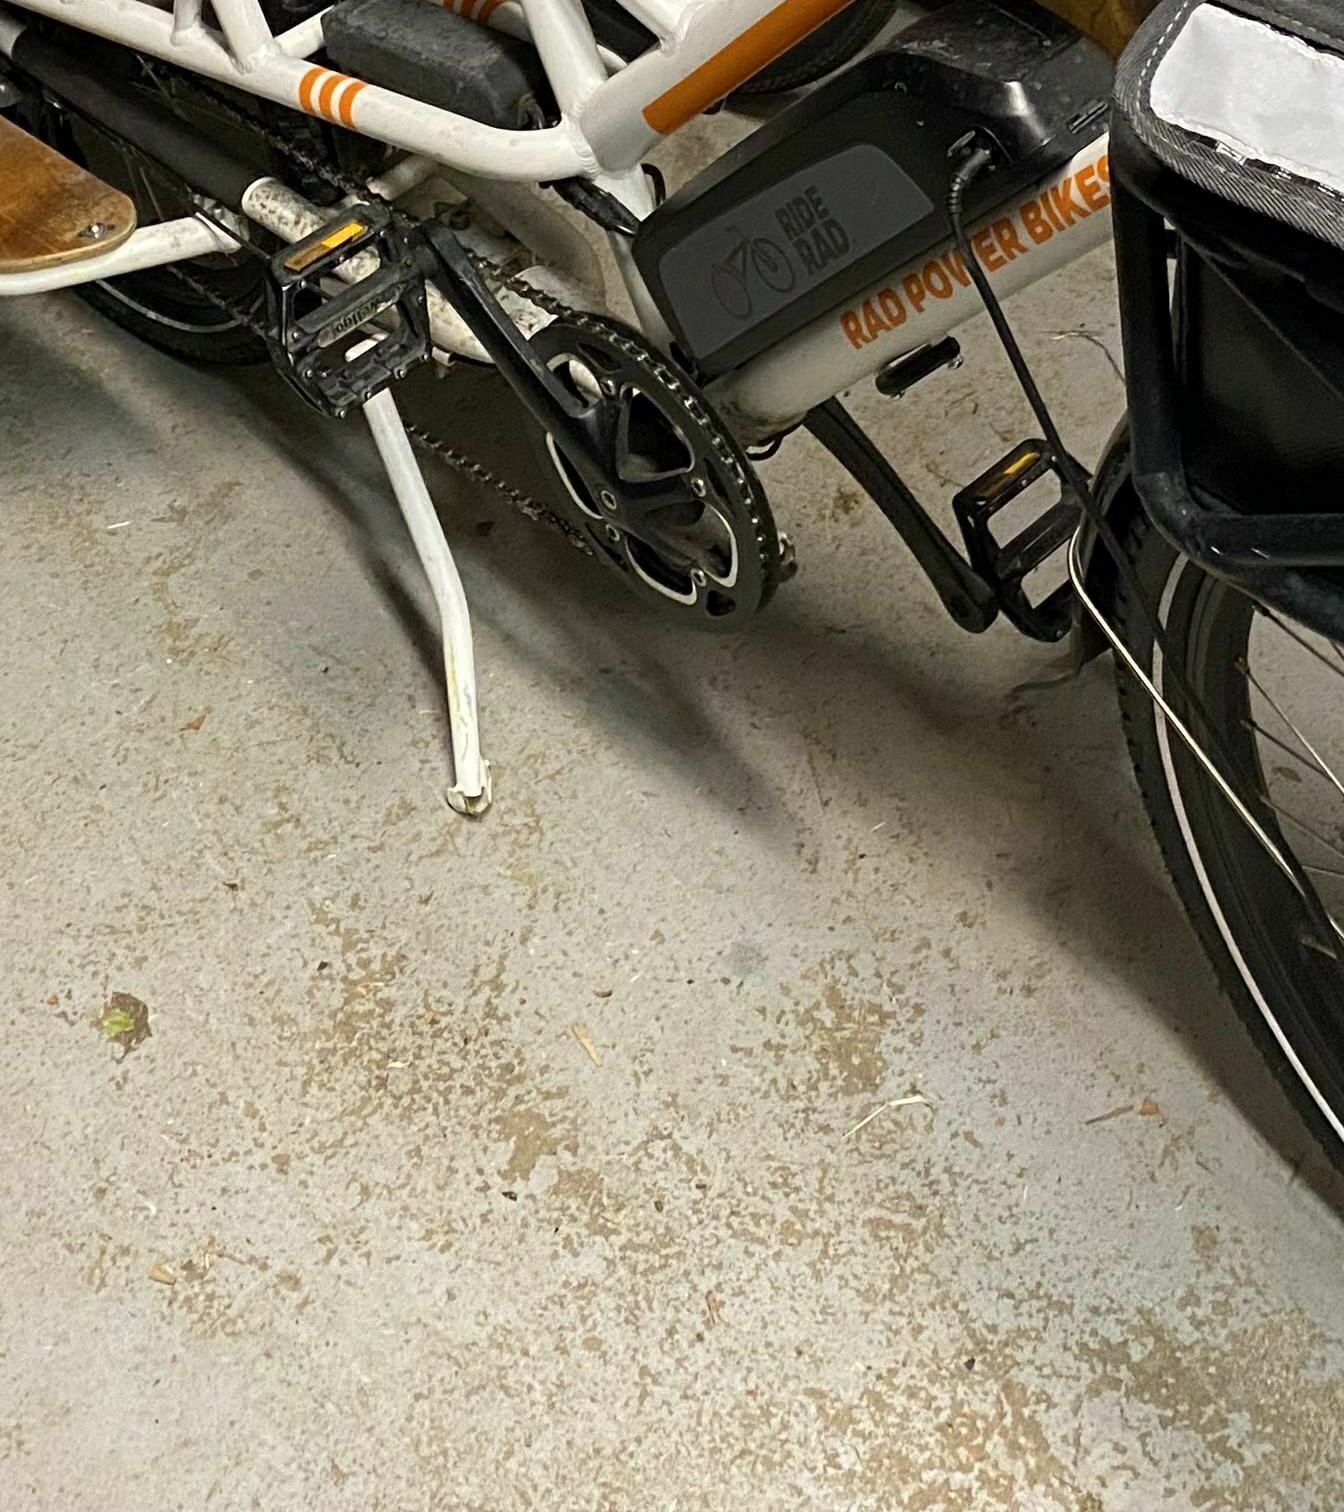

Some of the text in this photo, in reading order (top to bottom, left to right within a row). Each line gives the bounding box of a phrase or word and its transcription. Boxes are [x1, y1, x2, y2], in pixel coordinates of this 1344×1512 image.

[775, 185, 830, 241] RIDE
[792, 218, 850, 276] RAD
[840, 288, 907, 350] RAD
[1019, 154, 1112, 245] BIKES
